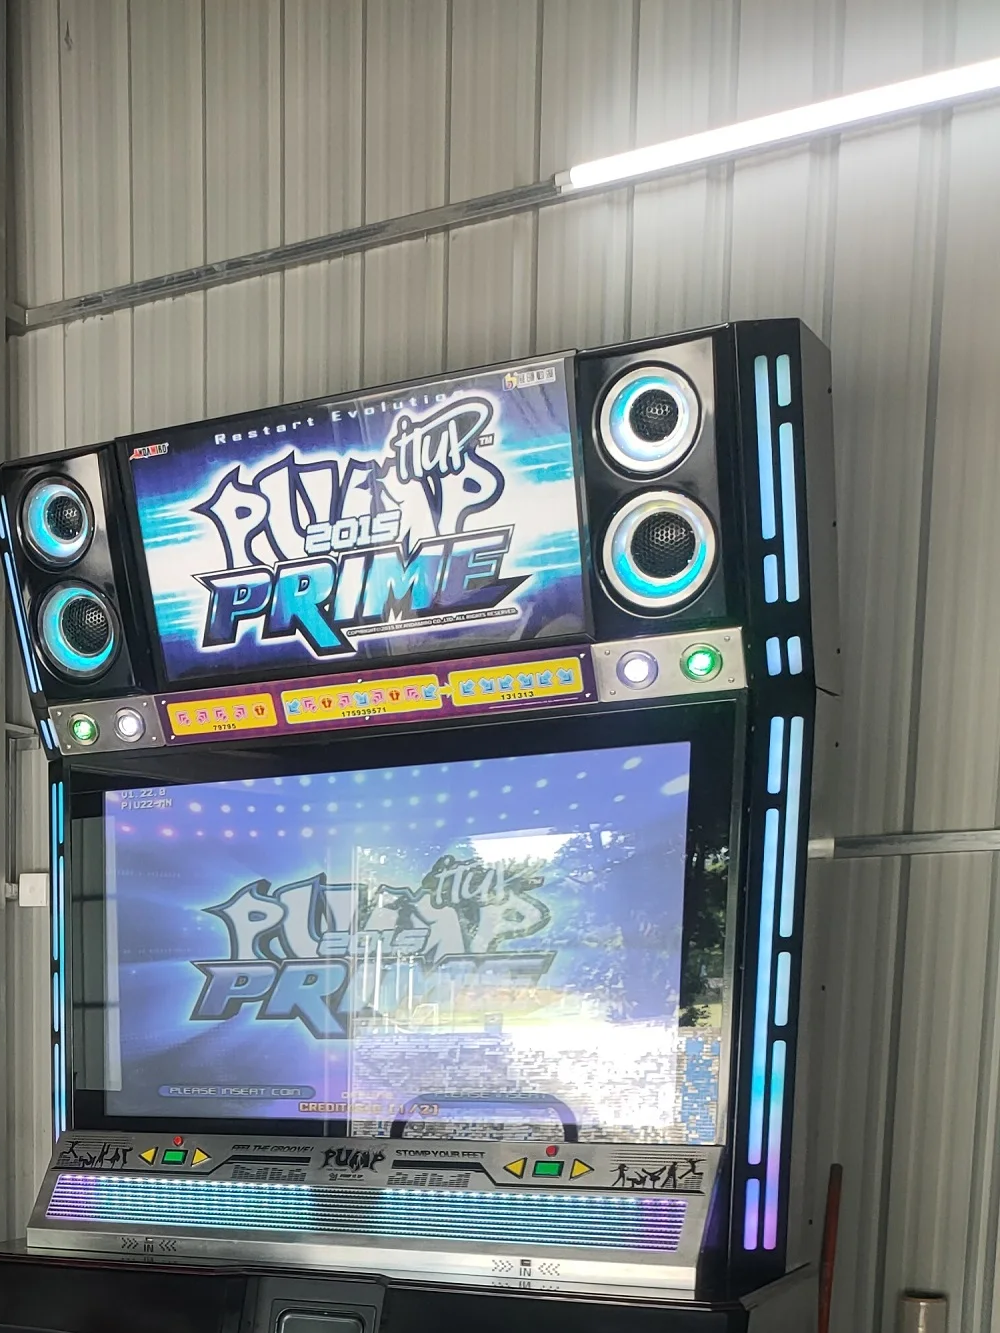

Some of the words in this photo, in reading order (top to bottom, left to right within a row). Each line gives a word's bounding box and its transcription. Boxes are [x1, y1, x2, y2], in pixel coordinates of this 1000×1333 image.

[214, 417, 315, 445] Restart
[331, 388, 464, 422] Evolution
[192, 449, 506, 570] PUMP
[304, 510, 403, 554] 2015
[192, 525, 531, 656] PRIME
[501, 690, 535, 700] 131313
[341, 706, 387, 718] 175939571
[212, 723, 237, 731] 79795
[169, 1087, 217, 1096] PLEASE
[221, 1087, 266, 1096] INSERT
[271, 1087, 301, 1096] COIN
[143, 1244, 154, 1253] IN
[519, 1267, 532, 1277] IN
